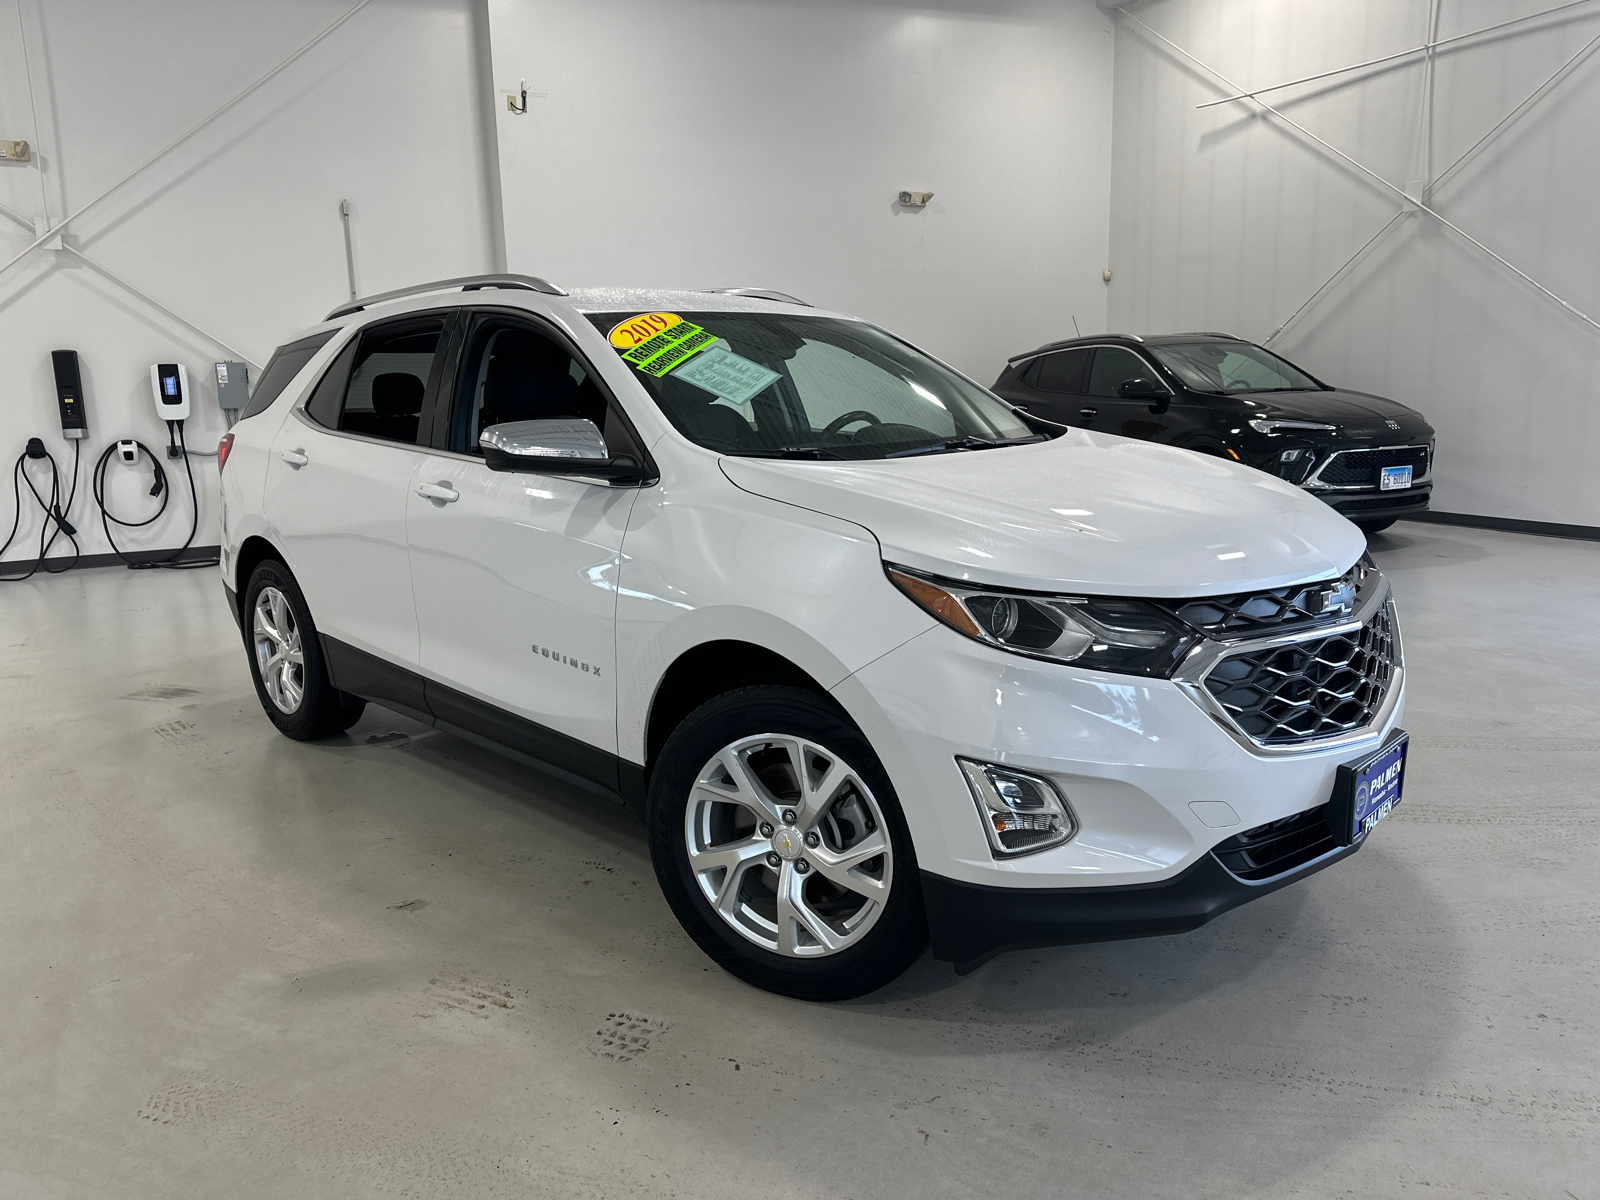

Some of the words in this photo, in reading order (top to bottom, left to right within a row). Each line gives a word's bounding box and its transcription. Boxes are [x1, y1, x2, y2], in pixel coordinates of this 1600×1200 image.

[620, 314, 668, 344] 2019
[627, 335, 674, 362] REMOTE
[663, 322, 696, 340] START
[642, 346, 687, 374] REARVIEW
[678, 331, 711, 352] CAMERA
[531, 643, 601, 677] EQUINOX
[1370, 757, 1402, 796] PALMEN
[1365, 797, 1393, 834] PALMEN
